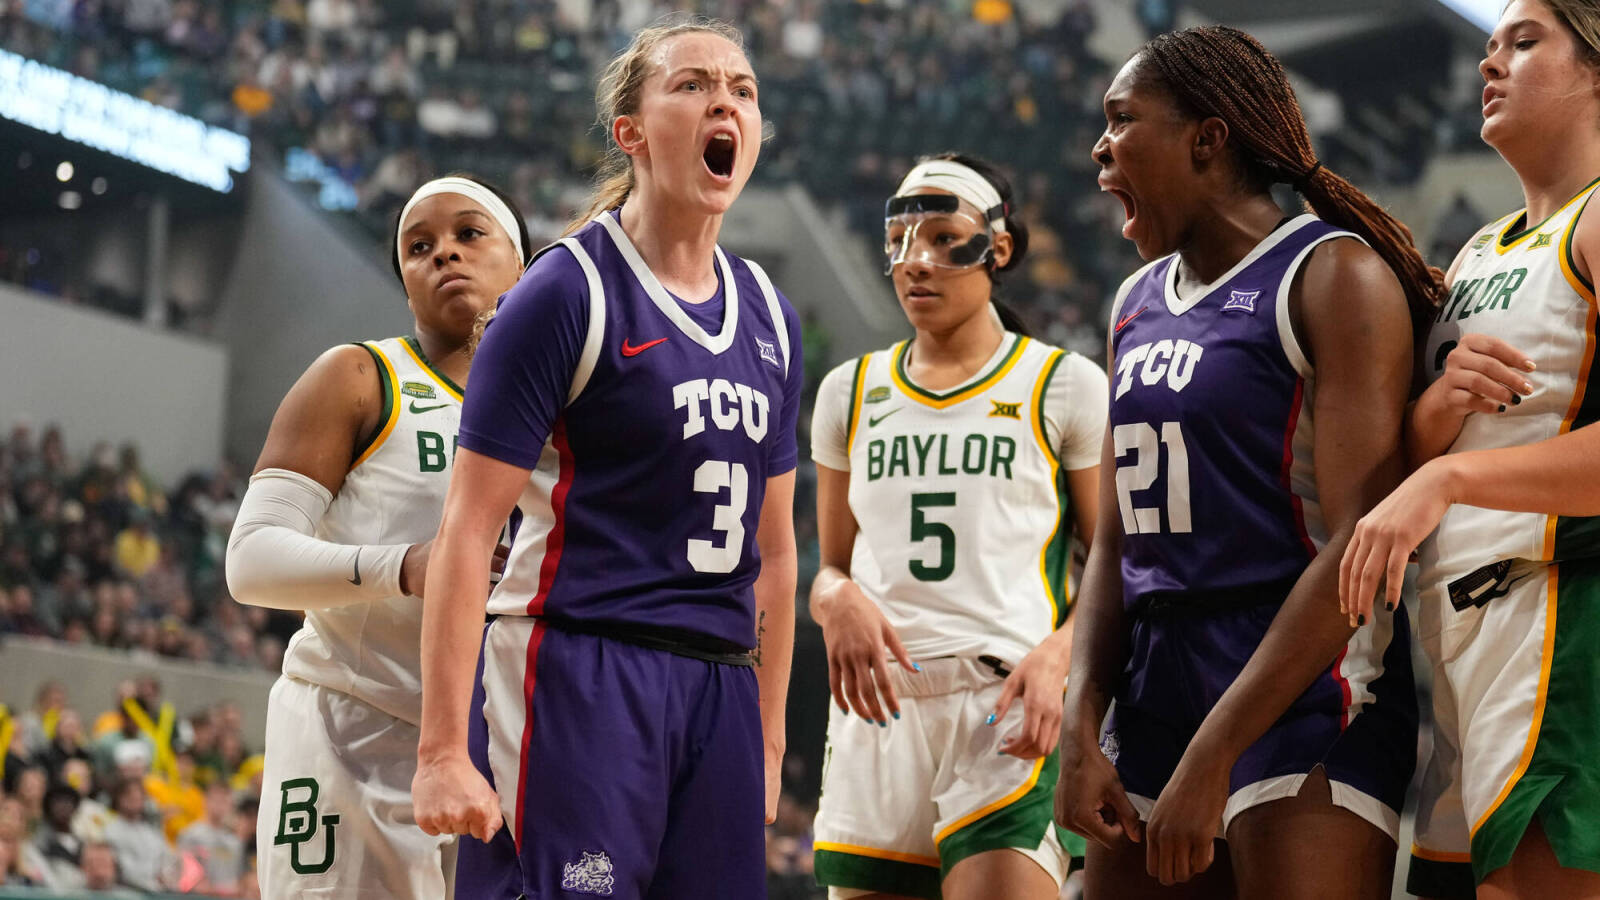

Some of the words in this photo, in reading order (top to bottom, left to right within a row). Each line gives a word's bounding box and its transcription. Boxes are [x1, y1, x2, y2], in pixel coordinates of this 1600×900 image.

[1115, 339, 1204, 401] TCU
[672, 378, 770, 444] TCU
[988, 399, 1023, 420] XII
[416, 430, 460, 472] B
[867, 433, 1017, 482] BAYLOR
[1113, 421, 1193, 535] 21
[687, 460, 749, 574] 3
[908, 492, 956, 582] 5
[274, 777, 340, 875] BU
